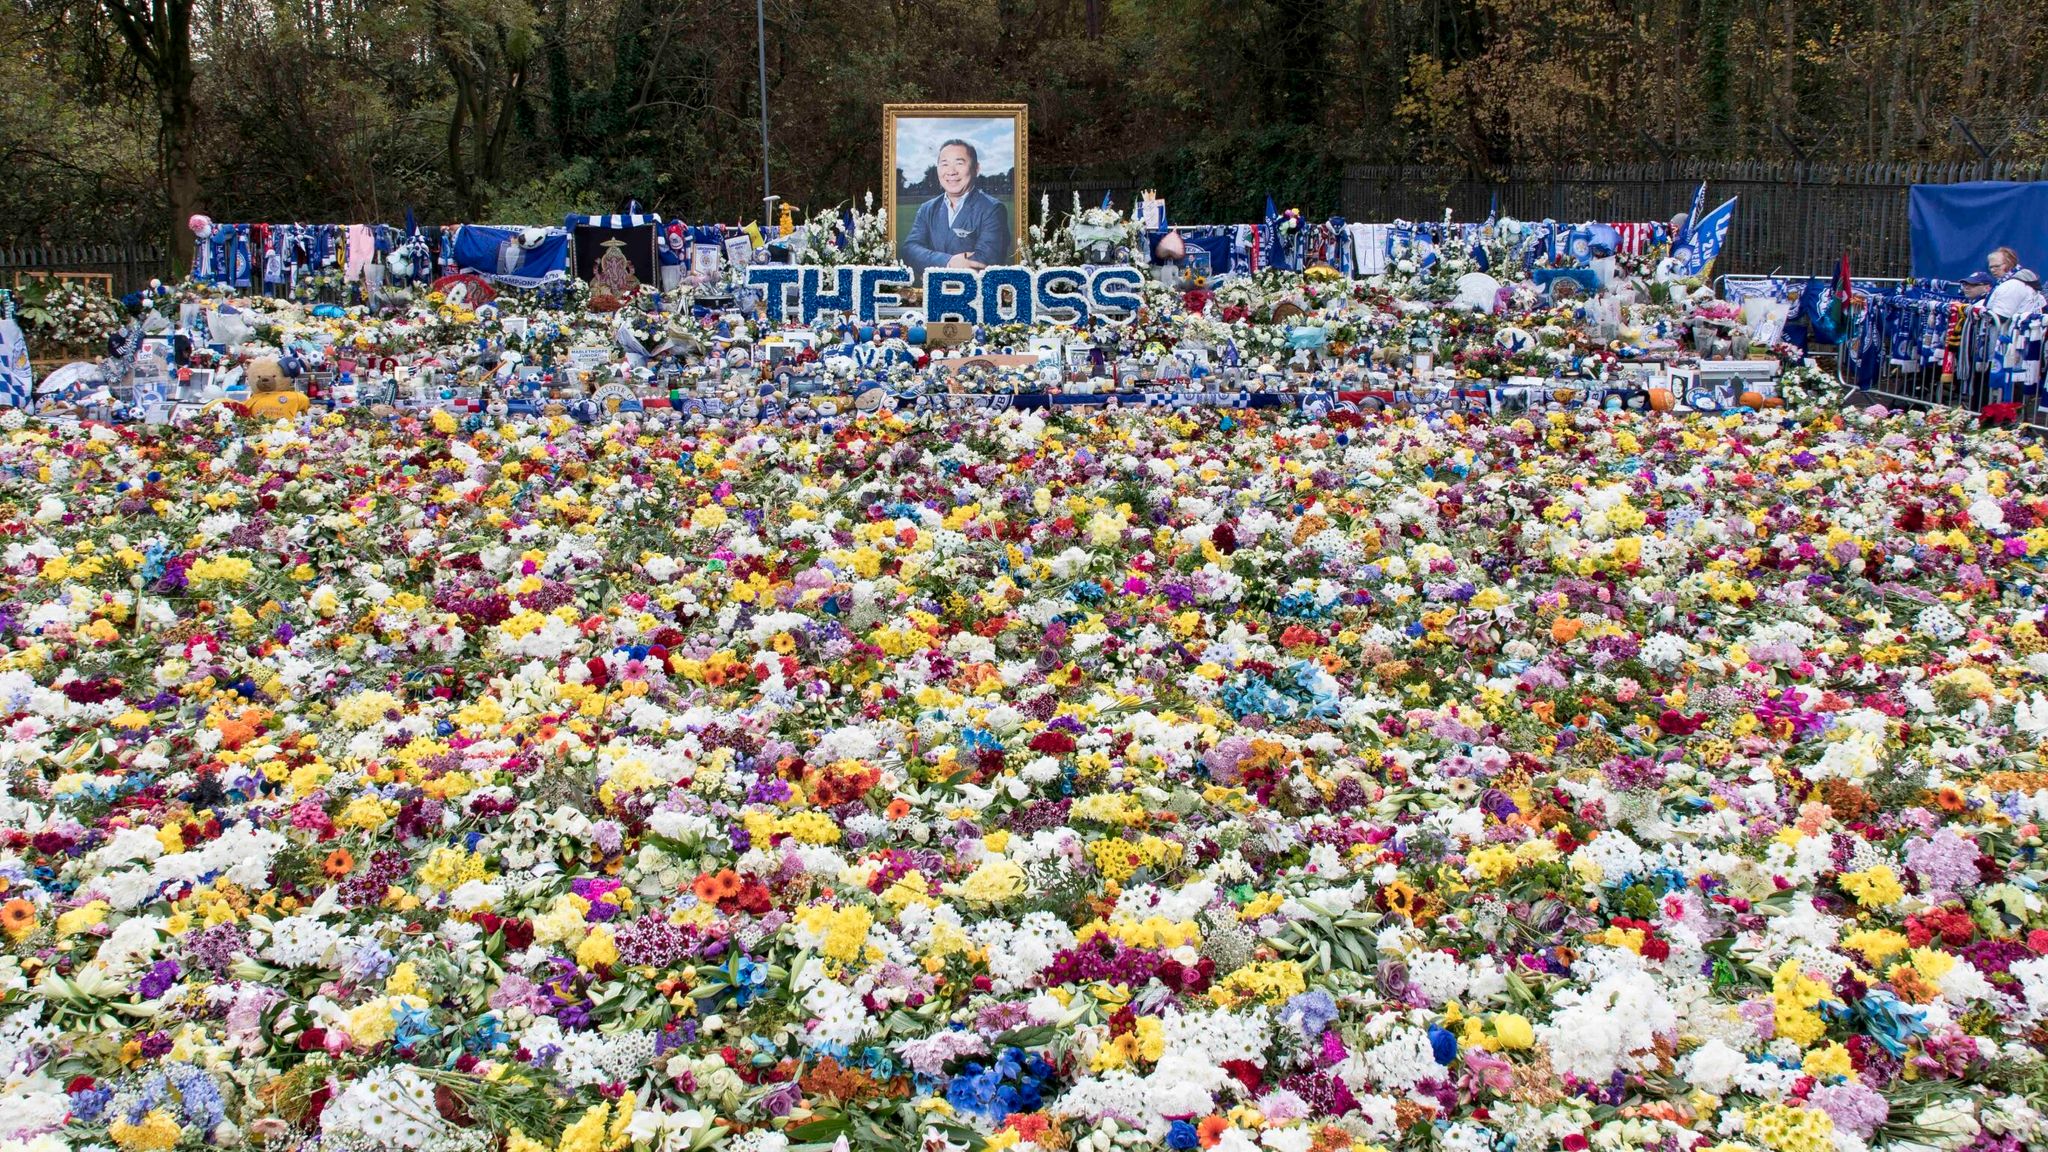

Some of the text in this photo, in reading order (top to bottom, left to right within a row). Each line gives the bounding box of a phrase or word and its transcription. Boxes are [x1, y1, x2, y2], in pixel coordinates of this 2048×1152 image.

[495, 274, 538, 287] CHAMPIONS
[745, 264, 1145, 326] THE BOSS
